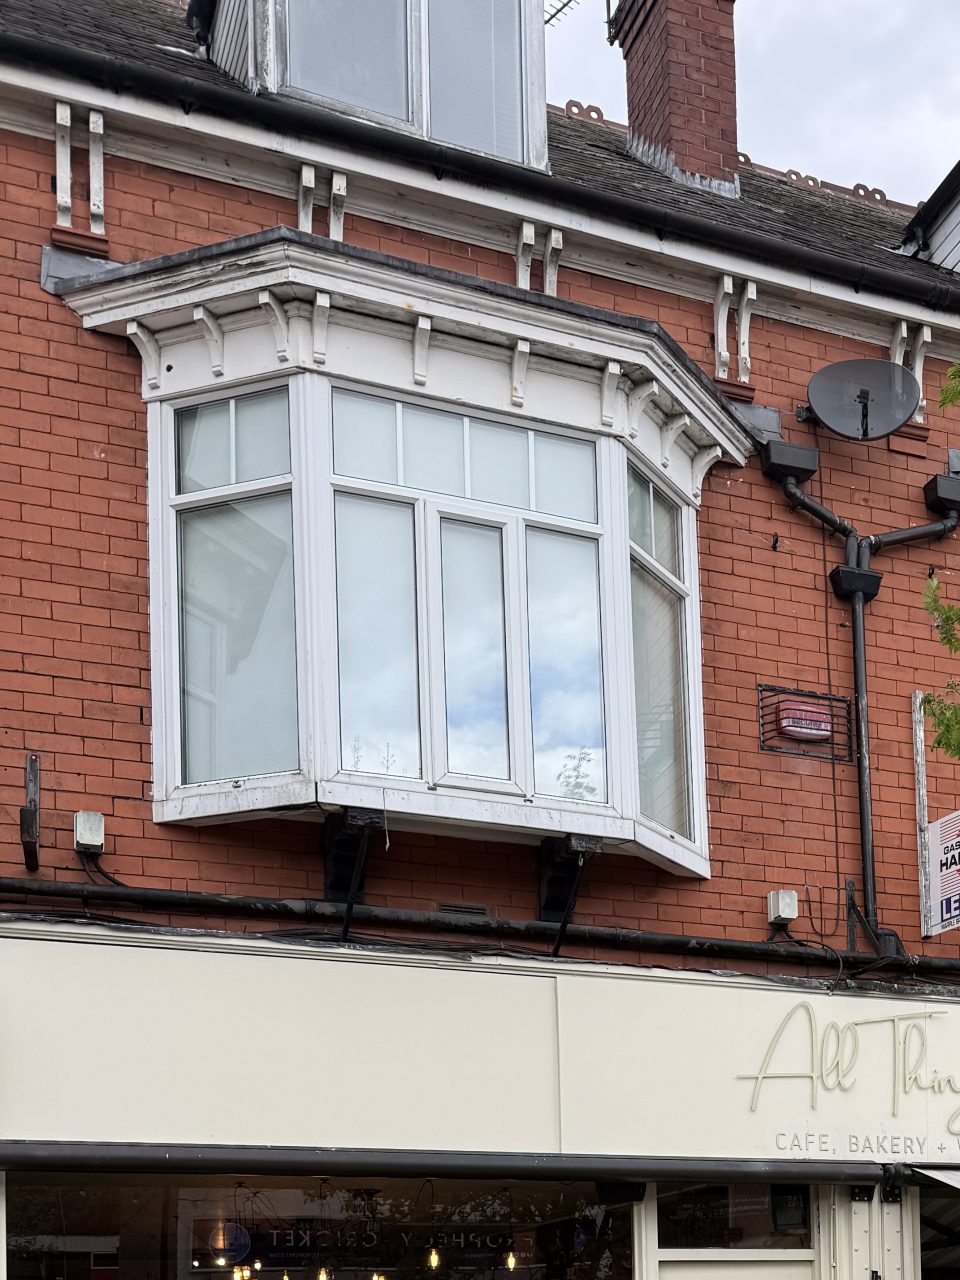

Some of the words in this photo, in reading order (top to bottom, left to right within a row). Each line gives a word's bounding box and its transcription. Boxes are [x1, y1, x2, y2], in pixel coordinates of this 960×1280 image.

[736, 1001, 859, 1113] All
[774, 1132, 837, 1156] CAFE,
[848, 1133, 928, 1156] BAKERY
[937, 1142, 948, 1155] +
